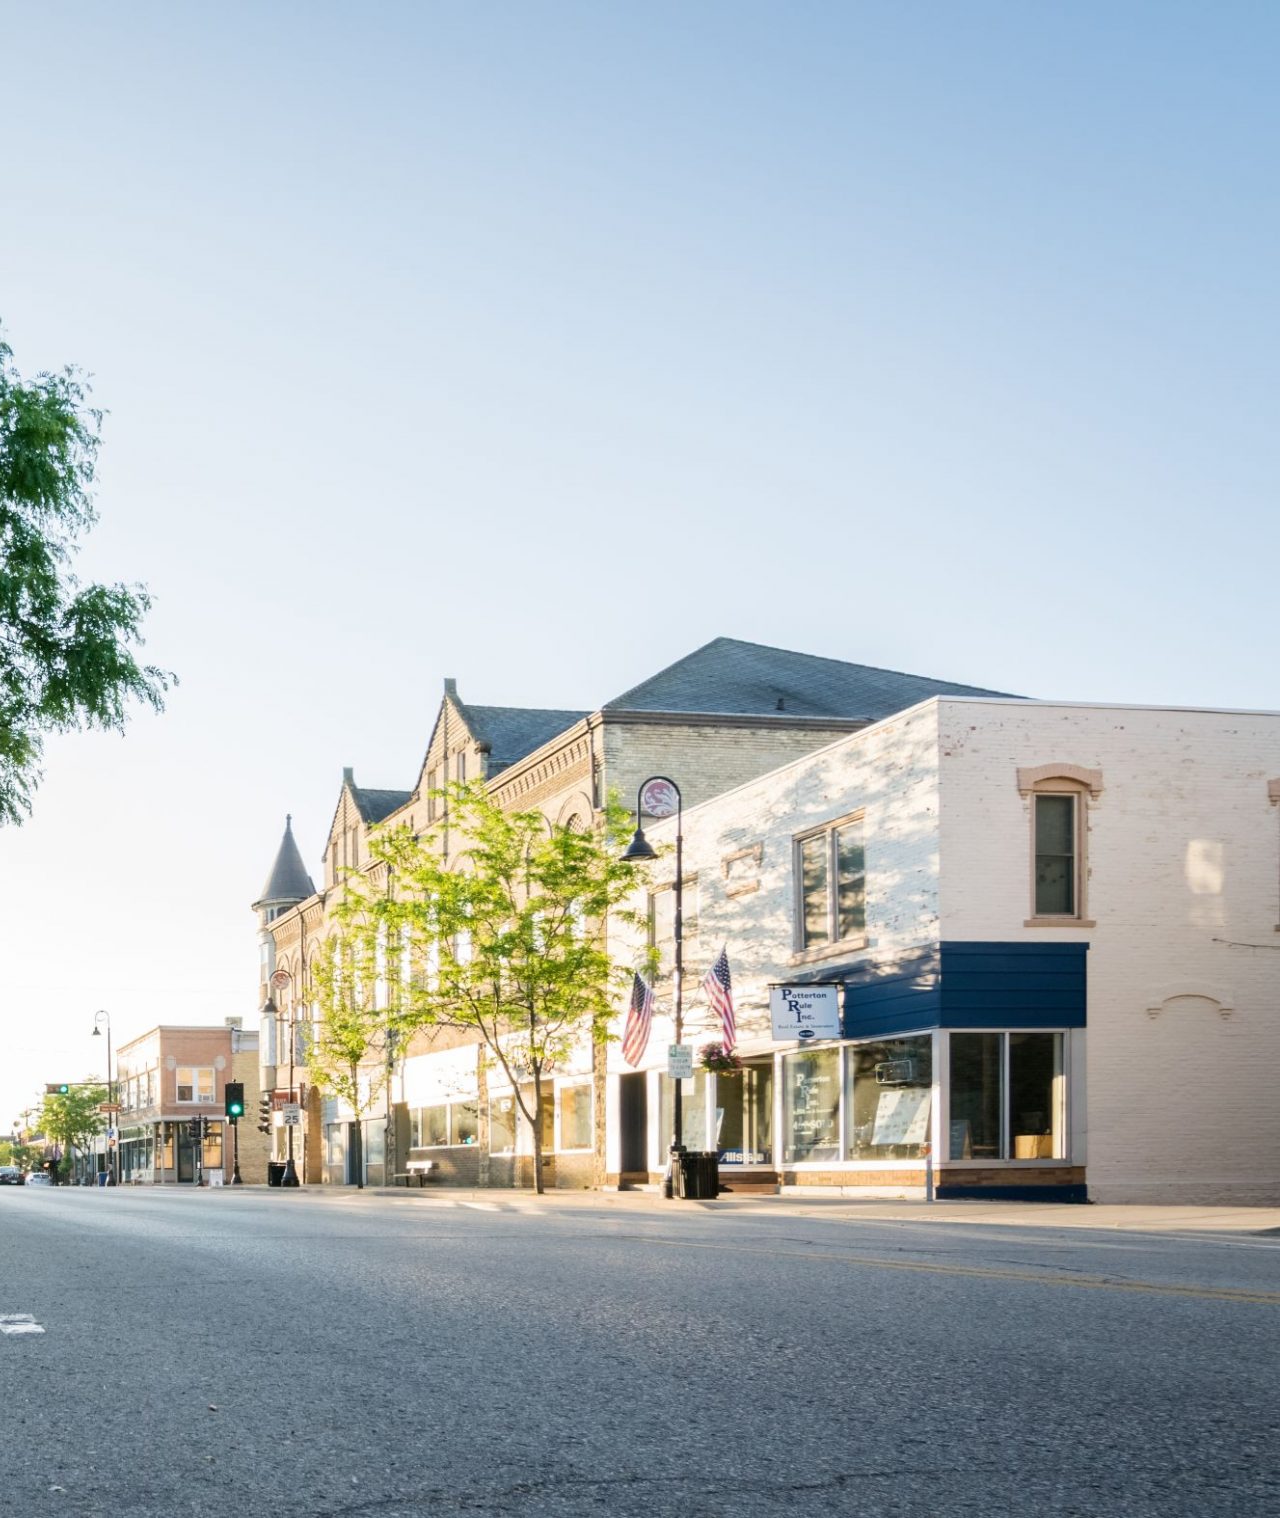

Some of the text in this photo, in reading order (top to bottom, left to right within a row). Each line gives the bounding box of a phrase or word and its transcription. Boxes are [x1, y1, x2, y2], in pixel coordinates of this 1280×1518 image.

[781, 988, 827, 1001] Potterton
[788, 1000, 813, 1012] Rule
[796, 1011, 815, 1023] Inc.
[285, 1115, 299, 1124] 25
[720, 1152, 764, 1162] Allsae
